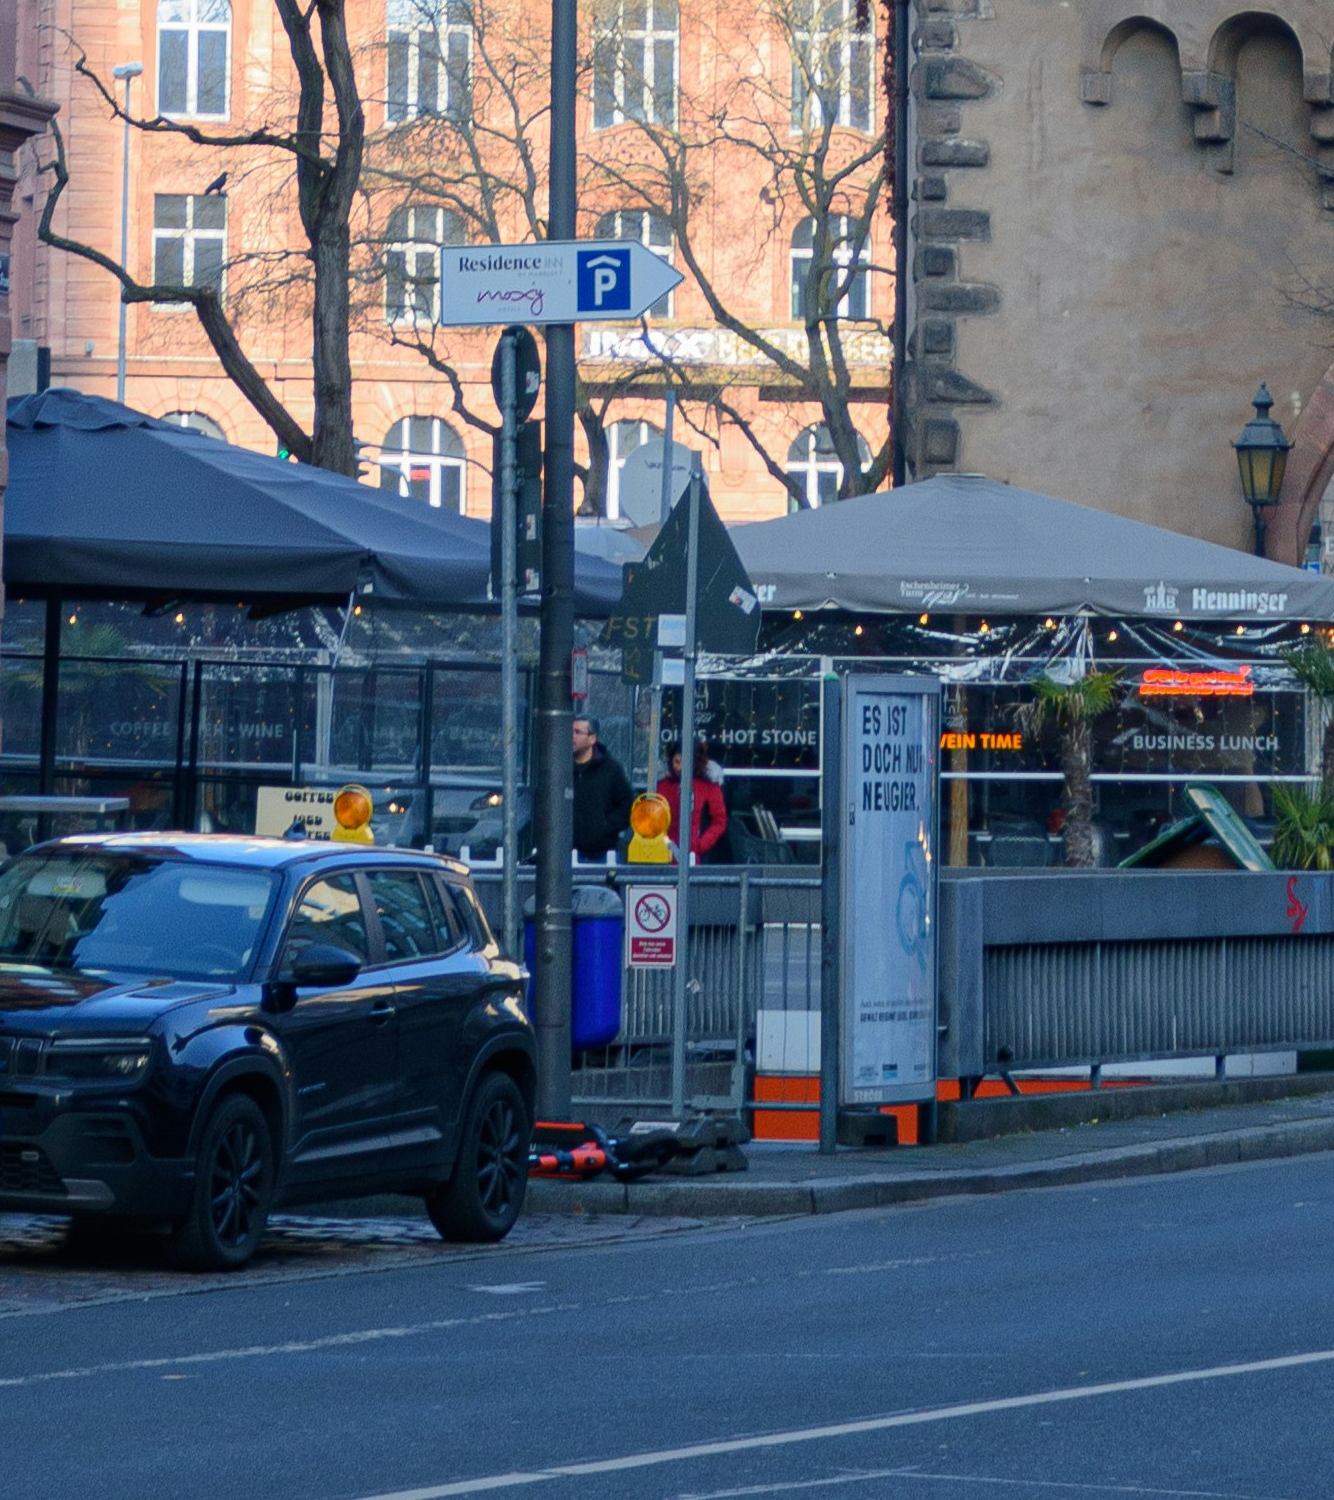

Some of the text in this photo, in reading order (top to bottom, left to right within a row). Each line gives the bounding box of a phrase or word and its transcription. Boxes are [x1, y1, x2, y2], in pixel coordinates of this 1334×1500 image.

[458, 254, 542, 273] Residence
[1191, 587, 1289, 614] Henninger
[110, 720, 171, 737] COFFEE
[239, 723, 284, 738] WINE
[861, 704, 908, 736] ES IST
[721, 729, 757, 744] HOT
[761, 730, 817, 745] STONE
[979, 733, 1023, 749] TIME
[1133, 735, 1279, 751] BUSINESS LUNCH
[862, 742, 902, 774] DOCH
[284, 791, 334, 804] COFFEE
[862, 780, 920, 812] NEUGIER.
